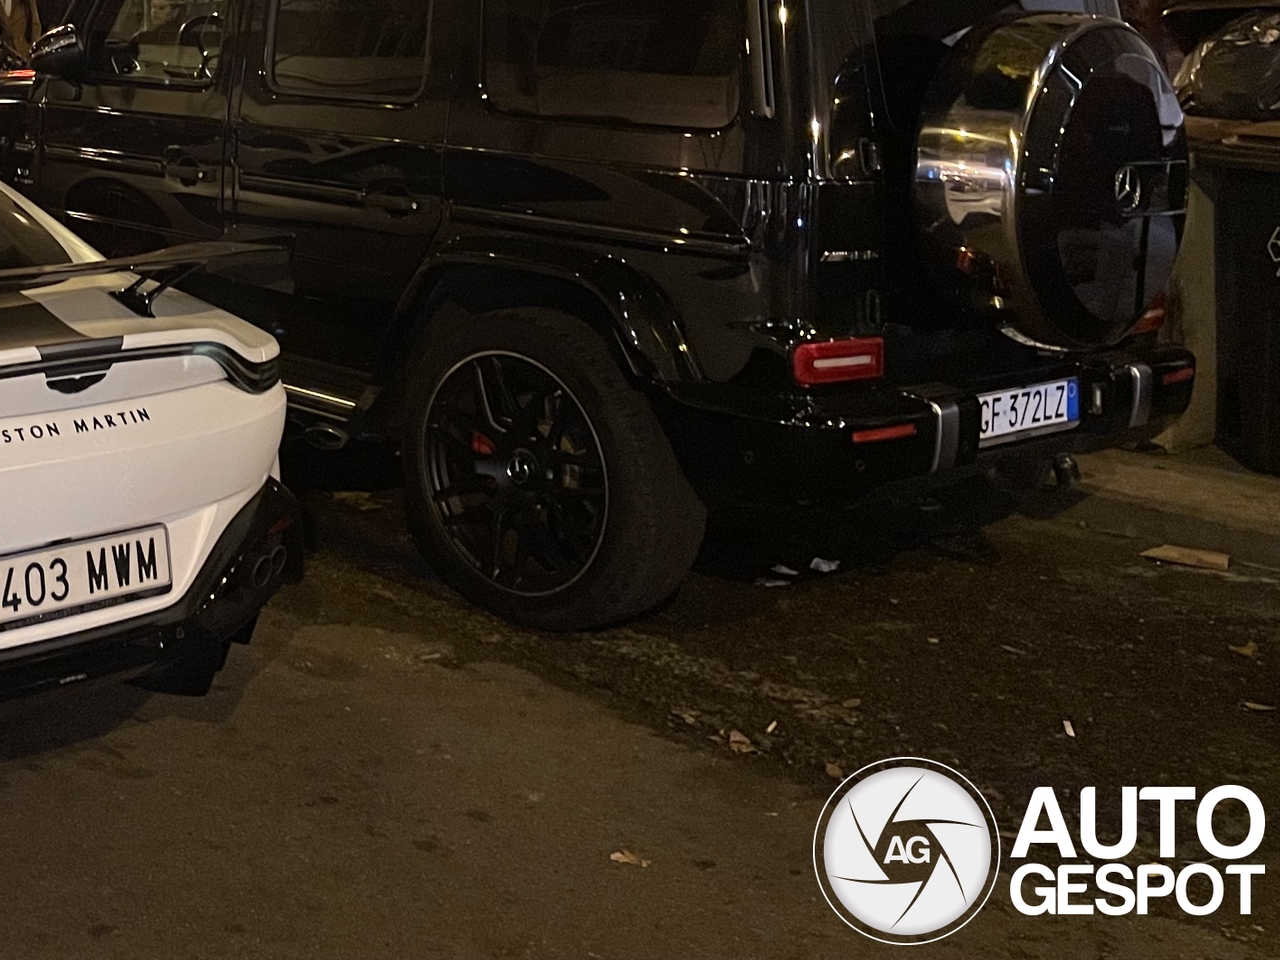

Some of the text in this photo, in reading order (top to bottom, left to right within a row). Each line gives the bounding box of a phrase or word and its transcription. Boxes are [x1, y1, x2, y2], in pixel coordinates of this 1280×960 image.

[72, 407, 151, 433] MARTIN
[1008, 384, 1065, 428] 372LZ
[86, 537, 158, 594] MWM
